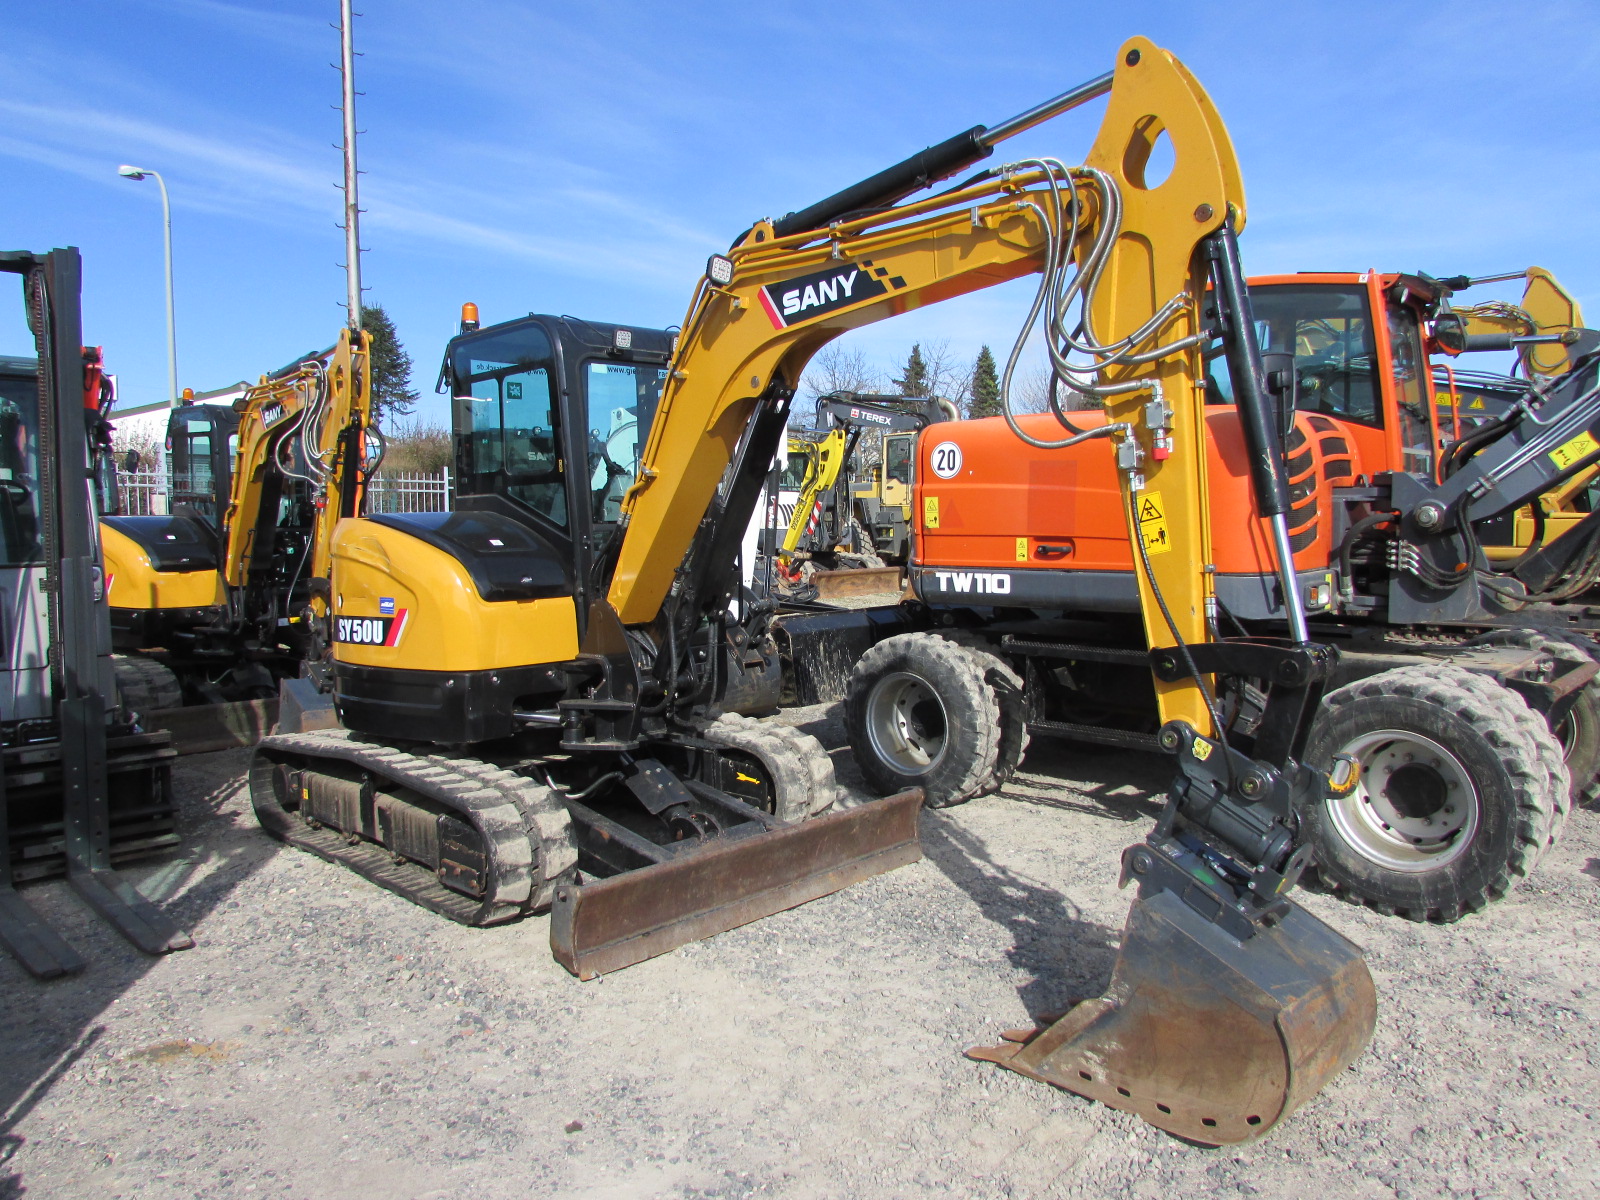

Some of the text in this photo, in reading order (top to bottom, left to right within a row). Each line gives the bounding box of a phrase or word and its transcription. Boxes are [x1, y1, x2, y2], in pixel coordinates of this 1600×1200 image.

[782, 269, 858, 316] SANY
[264, 404, 282, 424] SANY
[860, 410, 892, 426] TEREX
[527, 451, 554, 461] SAN
[937, 449, 956, 471] 20
[935, 571, 1011, 595] TW110
[338, 618, 384, 644] SY50U
